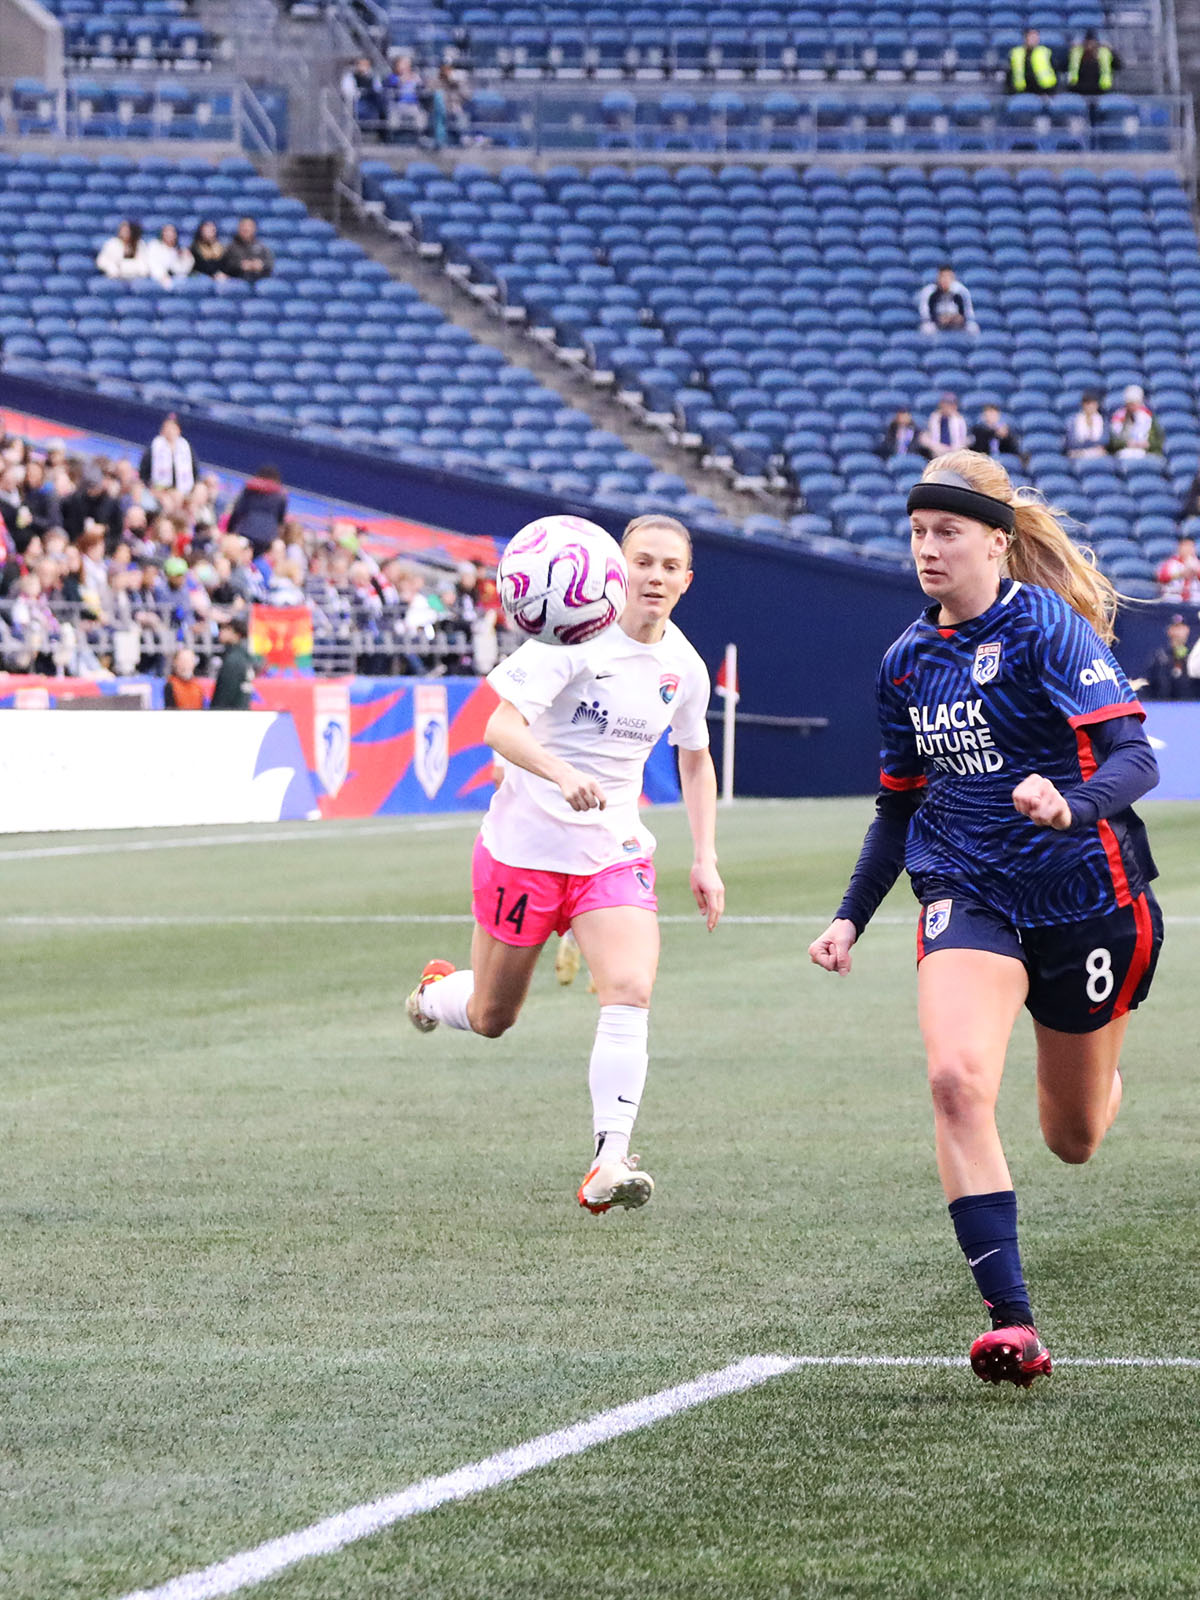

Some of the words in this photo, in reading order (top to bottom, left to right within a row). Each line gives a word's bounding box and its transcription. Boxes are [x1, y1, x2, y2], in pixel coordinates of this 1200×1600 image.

[1079, 658, 1119, 687] ally
[615, 715, 648, 730] KAISER
[908, 699, 988, 733] BLACK
[915, 726, 996, 757] FUTURE
[940, 750, 1005, 777] FUND
[494, 886, 529, 935] 14
[1085, 947, 1115, 1003] 8
